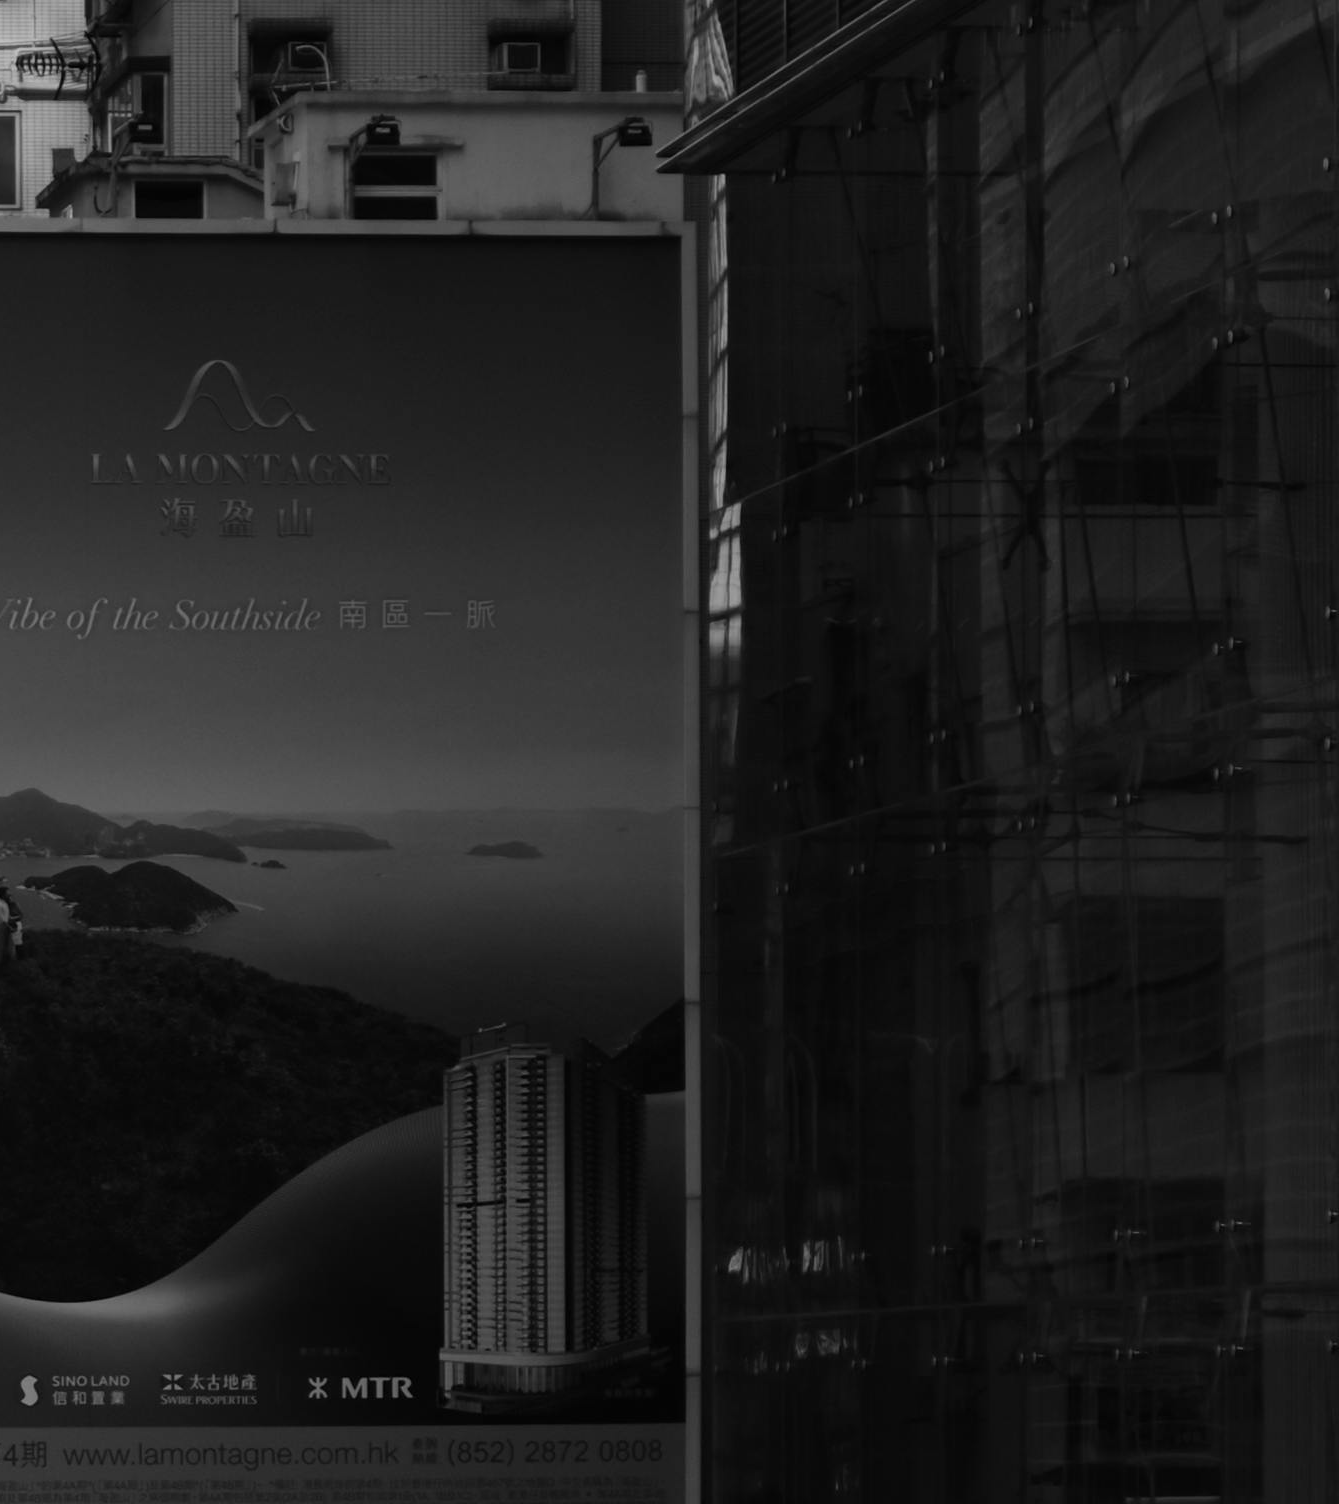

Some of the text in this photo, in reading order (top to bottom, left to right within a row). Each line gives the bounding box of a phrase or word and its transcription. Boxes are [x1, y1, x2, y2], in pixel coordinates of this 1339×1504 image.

[90, 453, 391, 485] LA MONTAGNE
[160, 498, 314, 538] 海盈山
[67, 598, 107, 640] of
[113, 599, 158, 631] the
[169, 599, 322, 632] Southside
[339, 599, 497, 631] 南區一脈
[52, 1375, 130, 1388] SINO LAND
[190, 1373, 258, 1391] 太古地產
[341, 1376, 414, 1399] MTR
[53, 1391, 126, 1406] 信和置業
[159, 1394, 258, 1406] SWIRE PROPERTIES
[63, 1442, 400, 1471] www.lamontagne.com.hk
[447, 1439, 663, 1467] (852) 2872 0808
